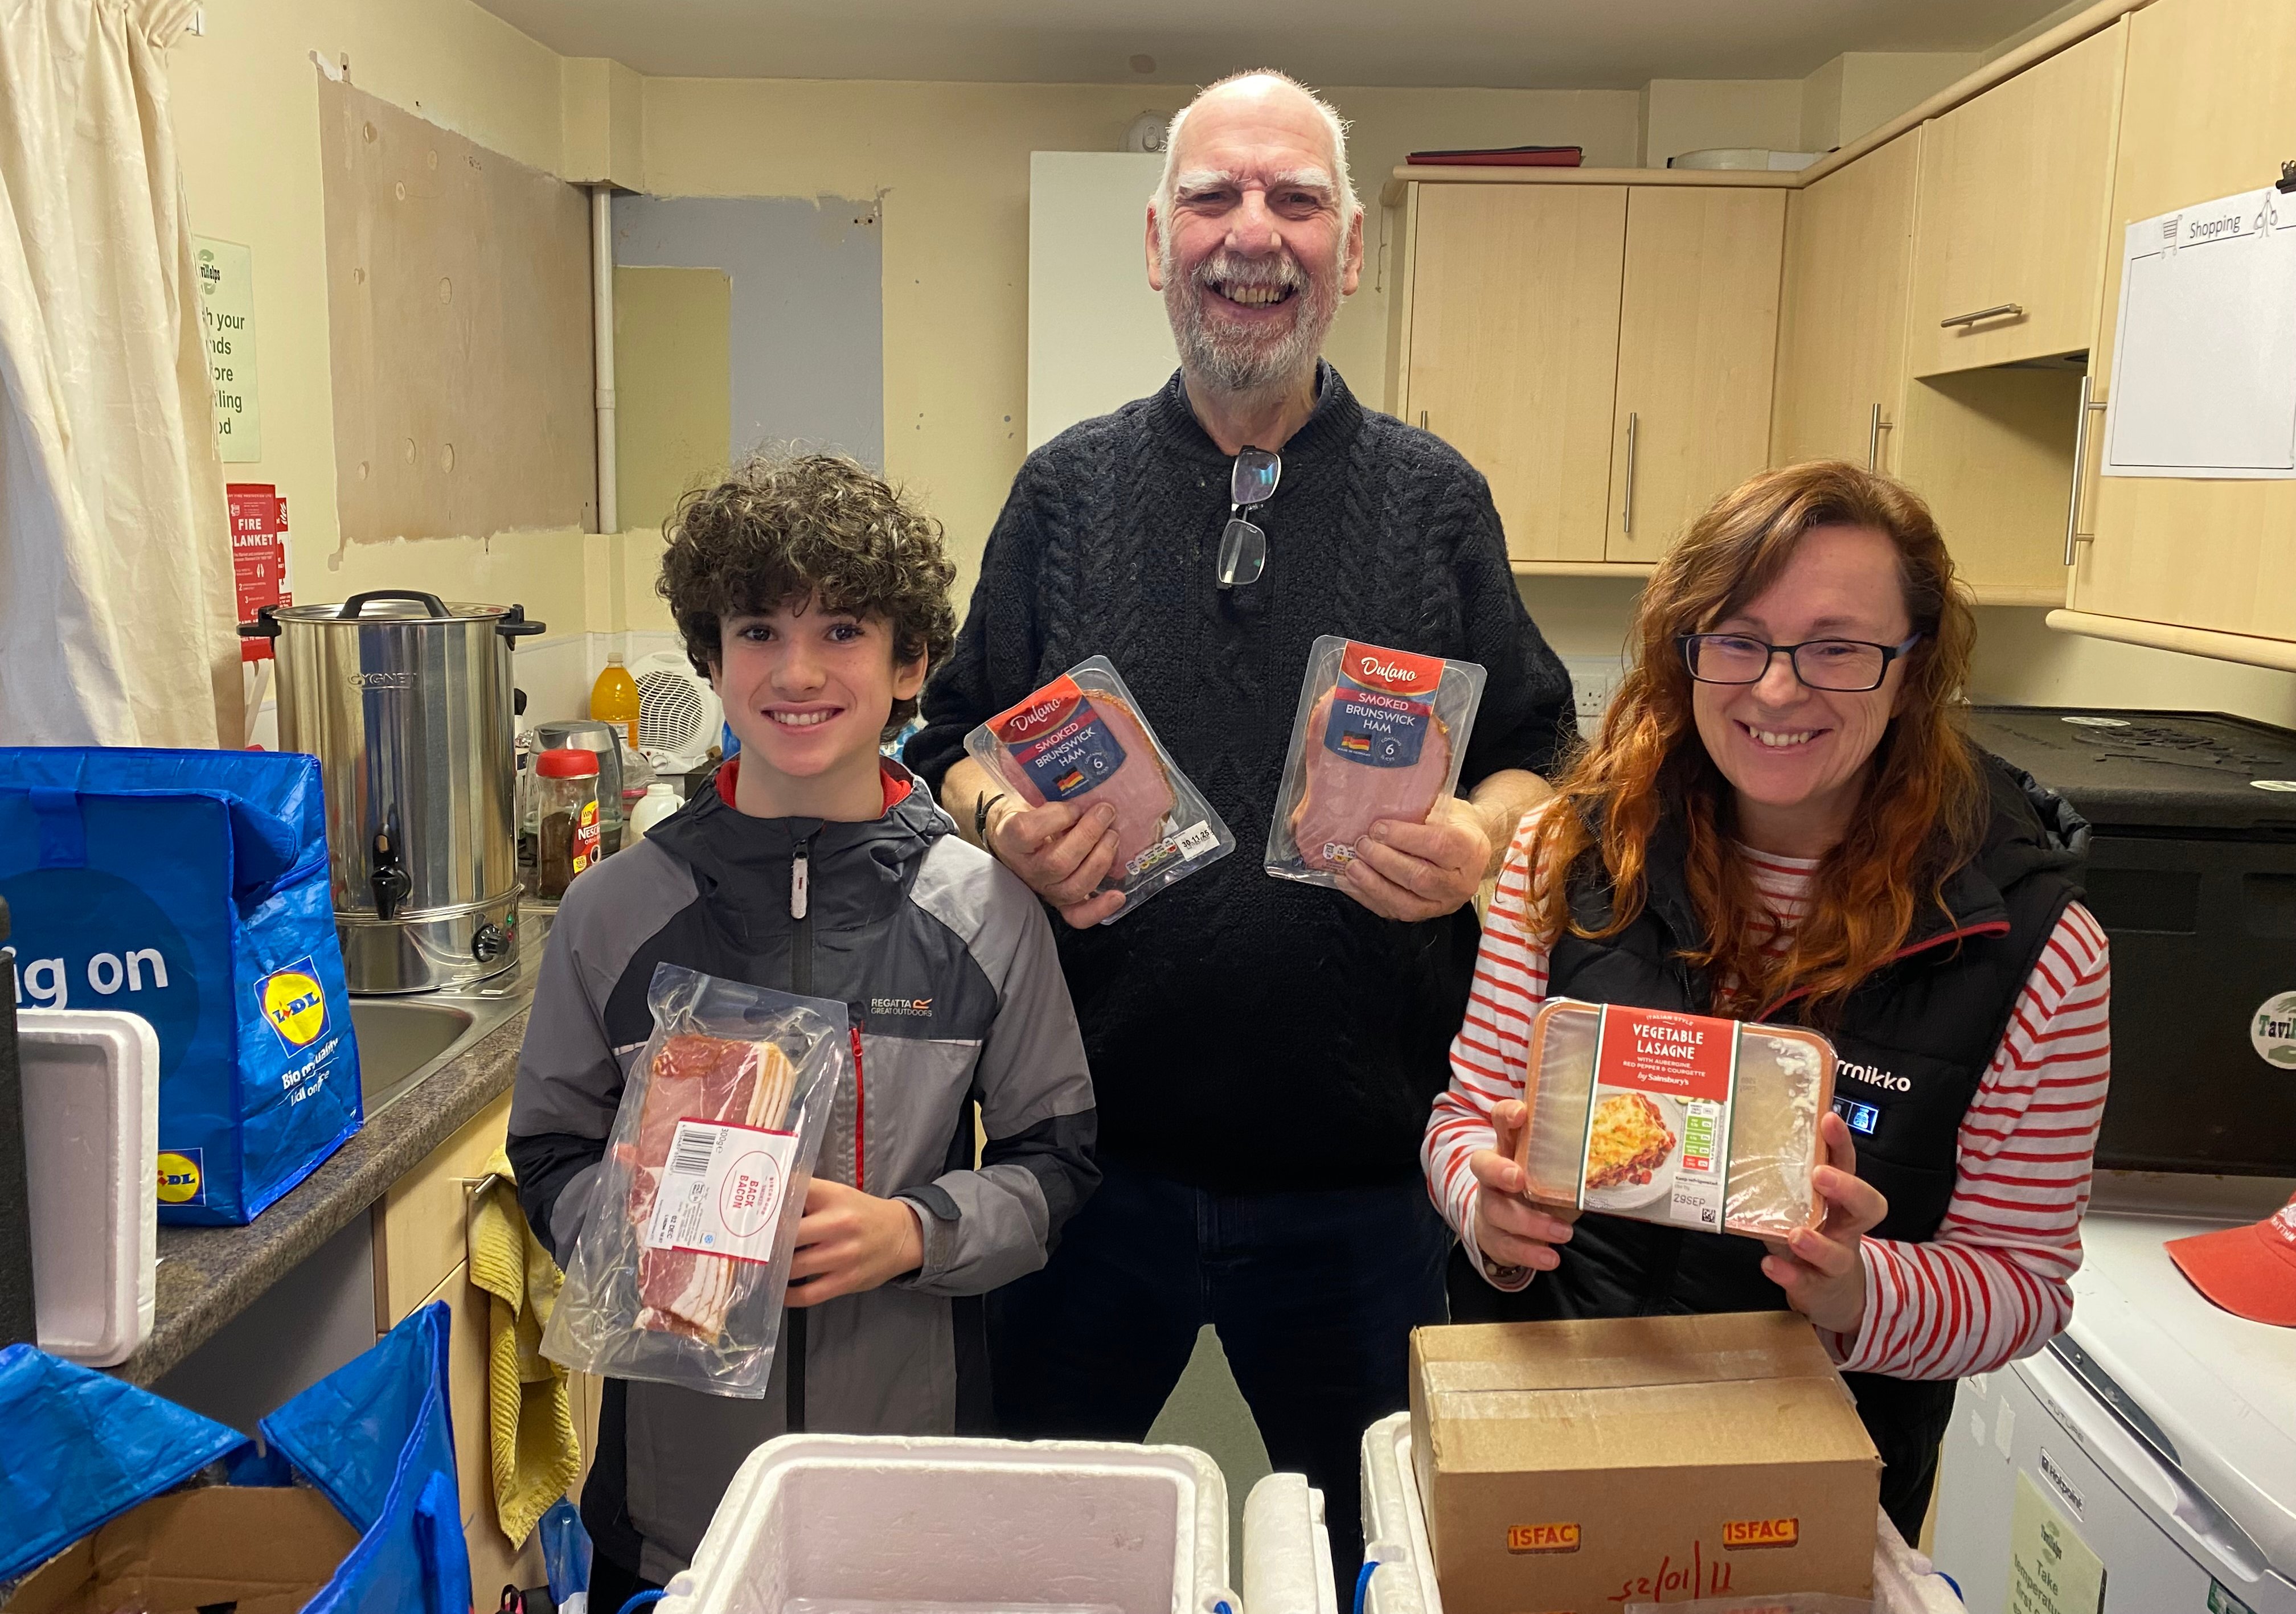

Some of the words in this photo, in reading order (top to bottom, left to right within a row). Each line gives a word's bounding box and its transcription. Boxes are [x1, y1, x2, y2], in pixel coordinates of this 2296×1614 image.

[2190, 215, 2241, 239] Shopping
[200, 264, 220, 283] viHelps
[217, 313, 245, 331] your
[210, 336, 231, 355] nds
[214, 367, 233, 381] ore
[216, 390, 242, 413] ling
[238, 518, 262, 531] FIRE
[232, 534, 273, 547] LANKET
[347, 673, 417, 685] CYGNET
[1361, 656, 1417, 683] Dulano
[1358, 692, 1408, 711] SMOKED
[1010, 698, 1061, 731] Dulano
[1346, 704, 1416, 726] BRUNSWICK
[1363, 720, 1391, 733] HAM
[1035, 722, 1079, 753] SMOKED
[1035, 727, 1096, 768] BRUNSWICK
[1385, 744, 1394, 755] 6
[1058, 749, 1086, 766] HAM
[1093, 758, 1102, 769] 6
[1182, 829, 1210, 847] 30.11.25
[88, 948, 169, 995] on
[871, 999, 912, 1008] REGATTA
[892, 1008, 932, 1017] OUTDOORS
[1674, 1016, 1694, 1026] STYLE
[1633, 1023, 1704, 1045] VEGETABLE
[313, 1037, 339, 1069] uality
[1637, 1040, 1695, 1059] LASAGNE
[1637, 1062, 1660, 1071] PEPPER
[1667, 1067, 1706, 1078] COURGETTE
[1637, 1071, 1647, 1082] by
[1648, 1073, 1690, 1086] Sainsbury's
[291, 1086, 306, 1107] Lidl
[732, 1174, 749, 1209] BACON
[745, 1180, 759, 1208] BACK
[667, 1224, 675, 1239] DEC
[2048, 1399, 2084, 1443] FUTURE
[2049, 1464, 2082, 1513] Hotpoint
[1510, 1524, 1577, 1546] ISFAC
[2036, 1559, 2059, 1596] Take
